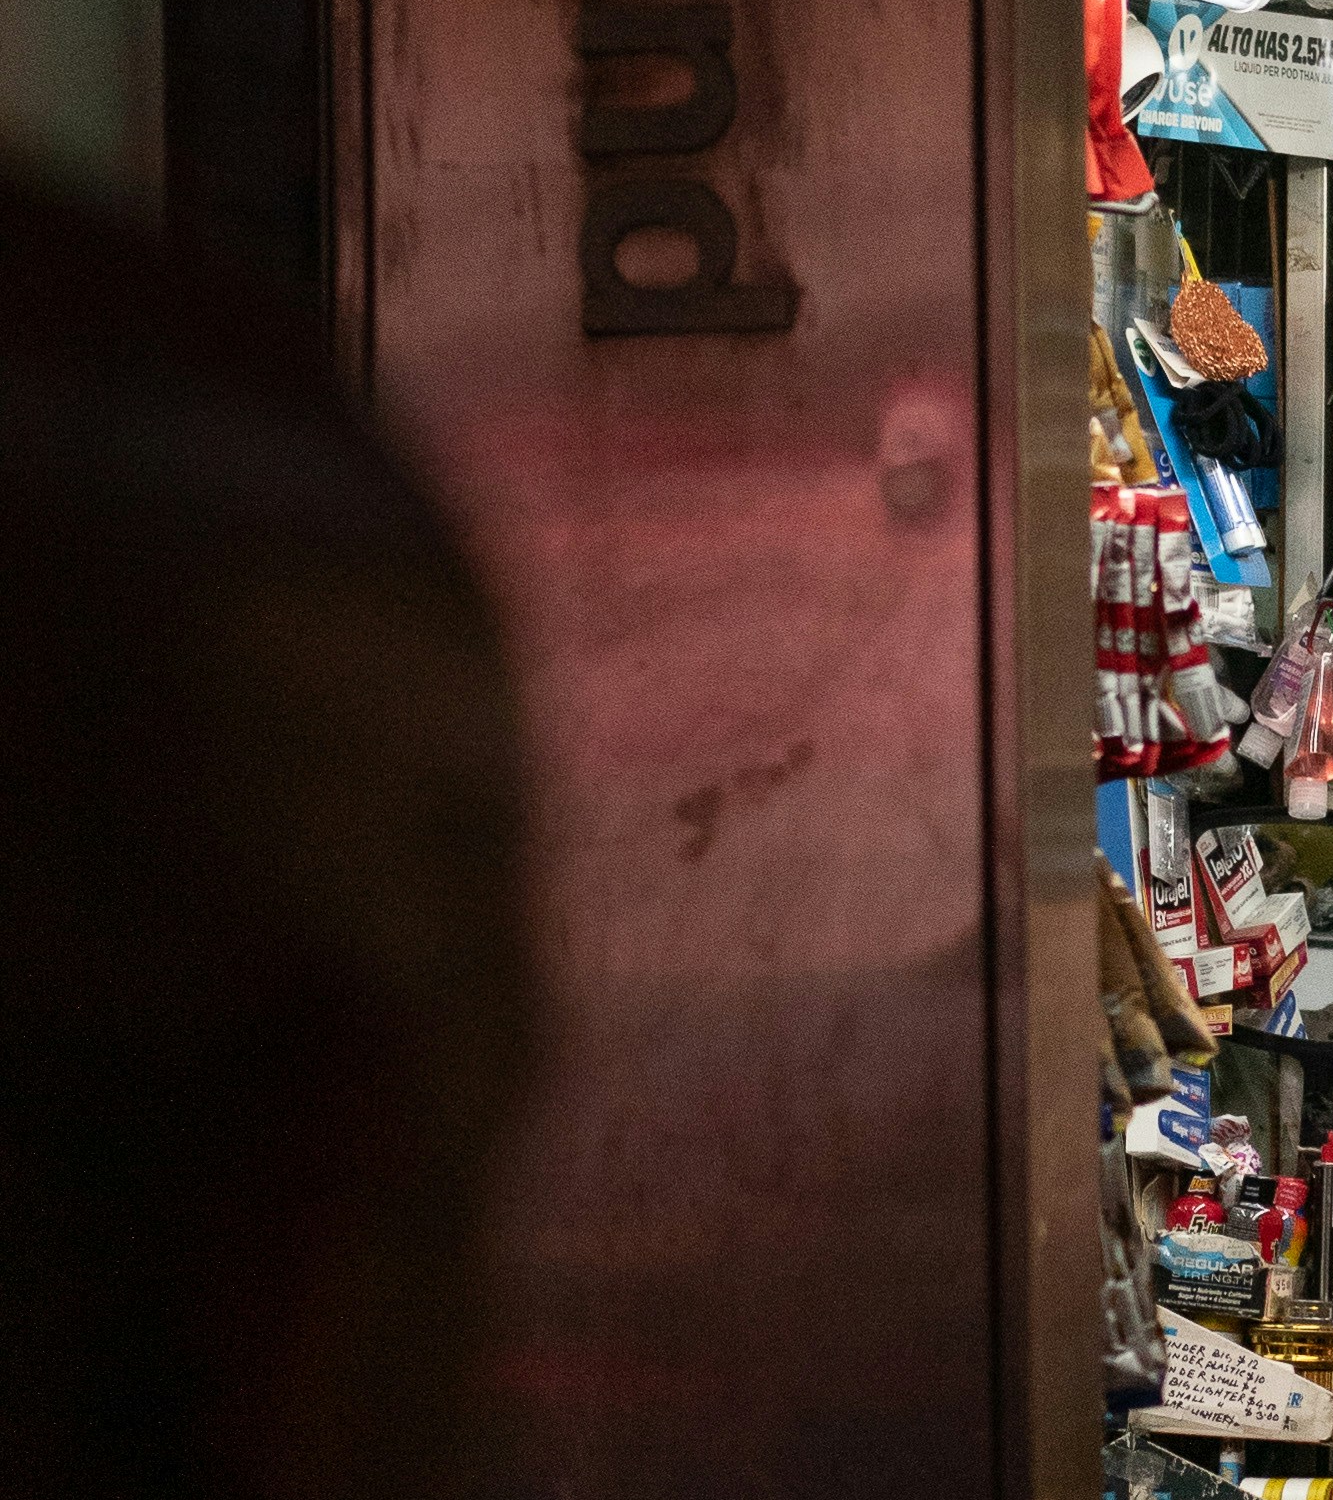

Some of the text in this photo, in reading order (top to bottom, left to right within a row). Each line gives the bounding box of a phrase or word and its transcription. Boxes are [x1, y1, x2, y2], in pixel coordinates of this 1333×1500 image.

[1208, 24, 1253, 56] ALTO
[1254, 31, 1289, 62] HAS
[1234, 60, 1262, 76] LIQUID
[1263, 64, 1280, 78] PER
[1281, 66, 1299, 80] POD
[1299, 68, 1321, 84] THAN
[1180, 114, 1223, 134] BEYOND
[1155, 909, 1168, 929] 3X
[1172, 1255, 1254, 1276] REGULAR
[1170, 1269, 1254, 1286] STRENGTH
[1167, 1341, 1206, 1358] INDER
[1167, 1352, 1204, 1368] INDER
[1168, 1366, 1207, 1382] NDER
